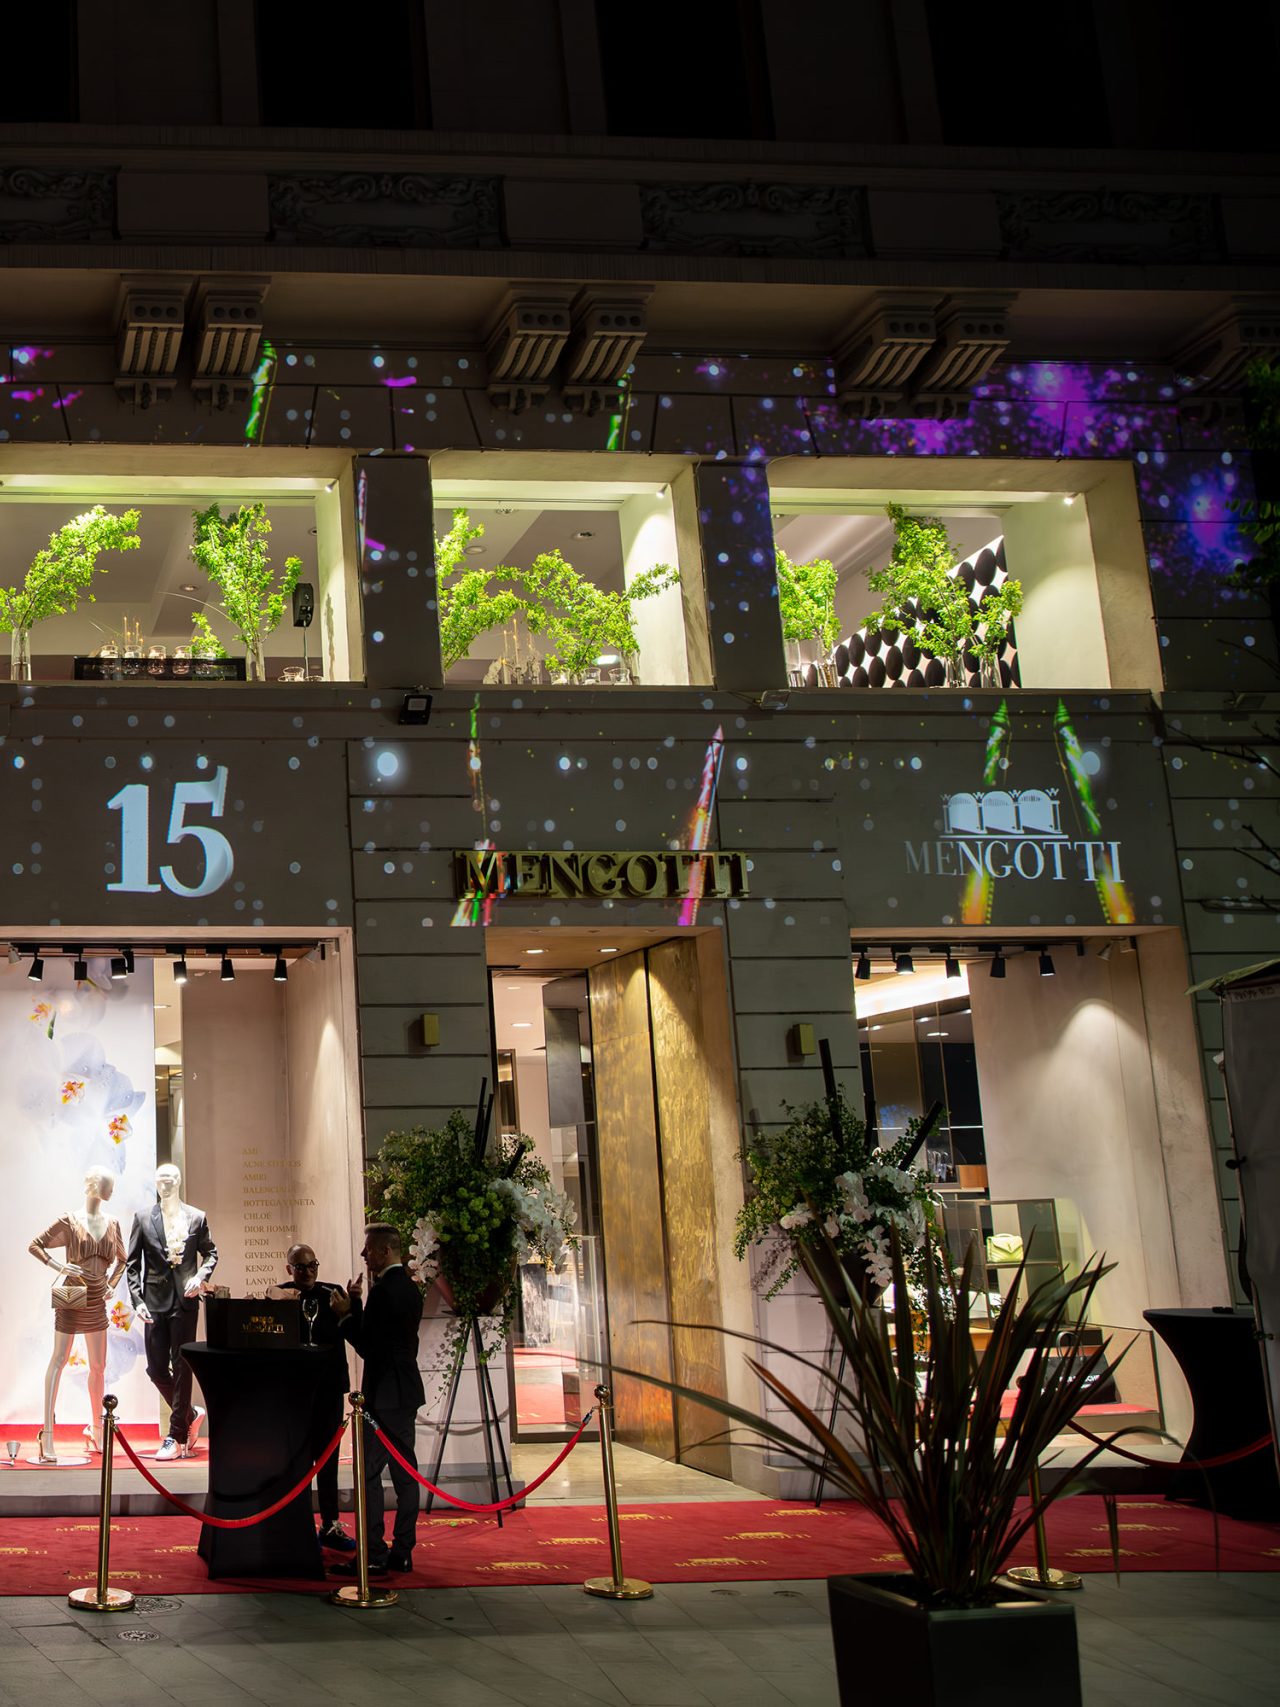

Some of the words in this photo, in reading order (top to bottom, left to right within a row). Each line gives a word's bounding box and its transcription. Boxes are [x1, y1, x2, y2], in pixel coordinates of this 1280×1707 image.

[107, 766, 235, 898] 15
[904, 840, 1125, 883] MENGOTTI
[455, 850, 751, 898] MENGOTTI
[244, 1225, 265, 1233] DIOR
[267, 1225, 298, 1233] HOMME
[244, 1238, 269, 1246] FENDI
[245, 1251, 287, 1260] GIVENCHY
[245, 1264, 274, 1272] KENZO
[246, 1277, 278, 1286] LANVIN
